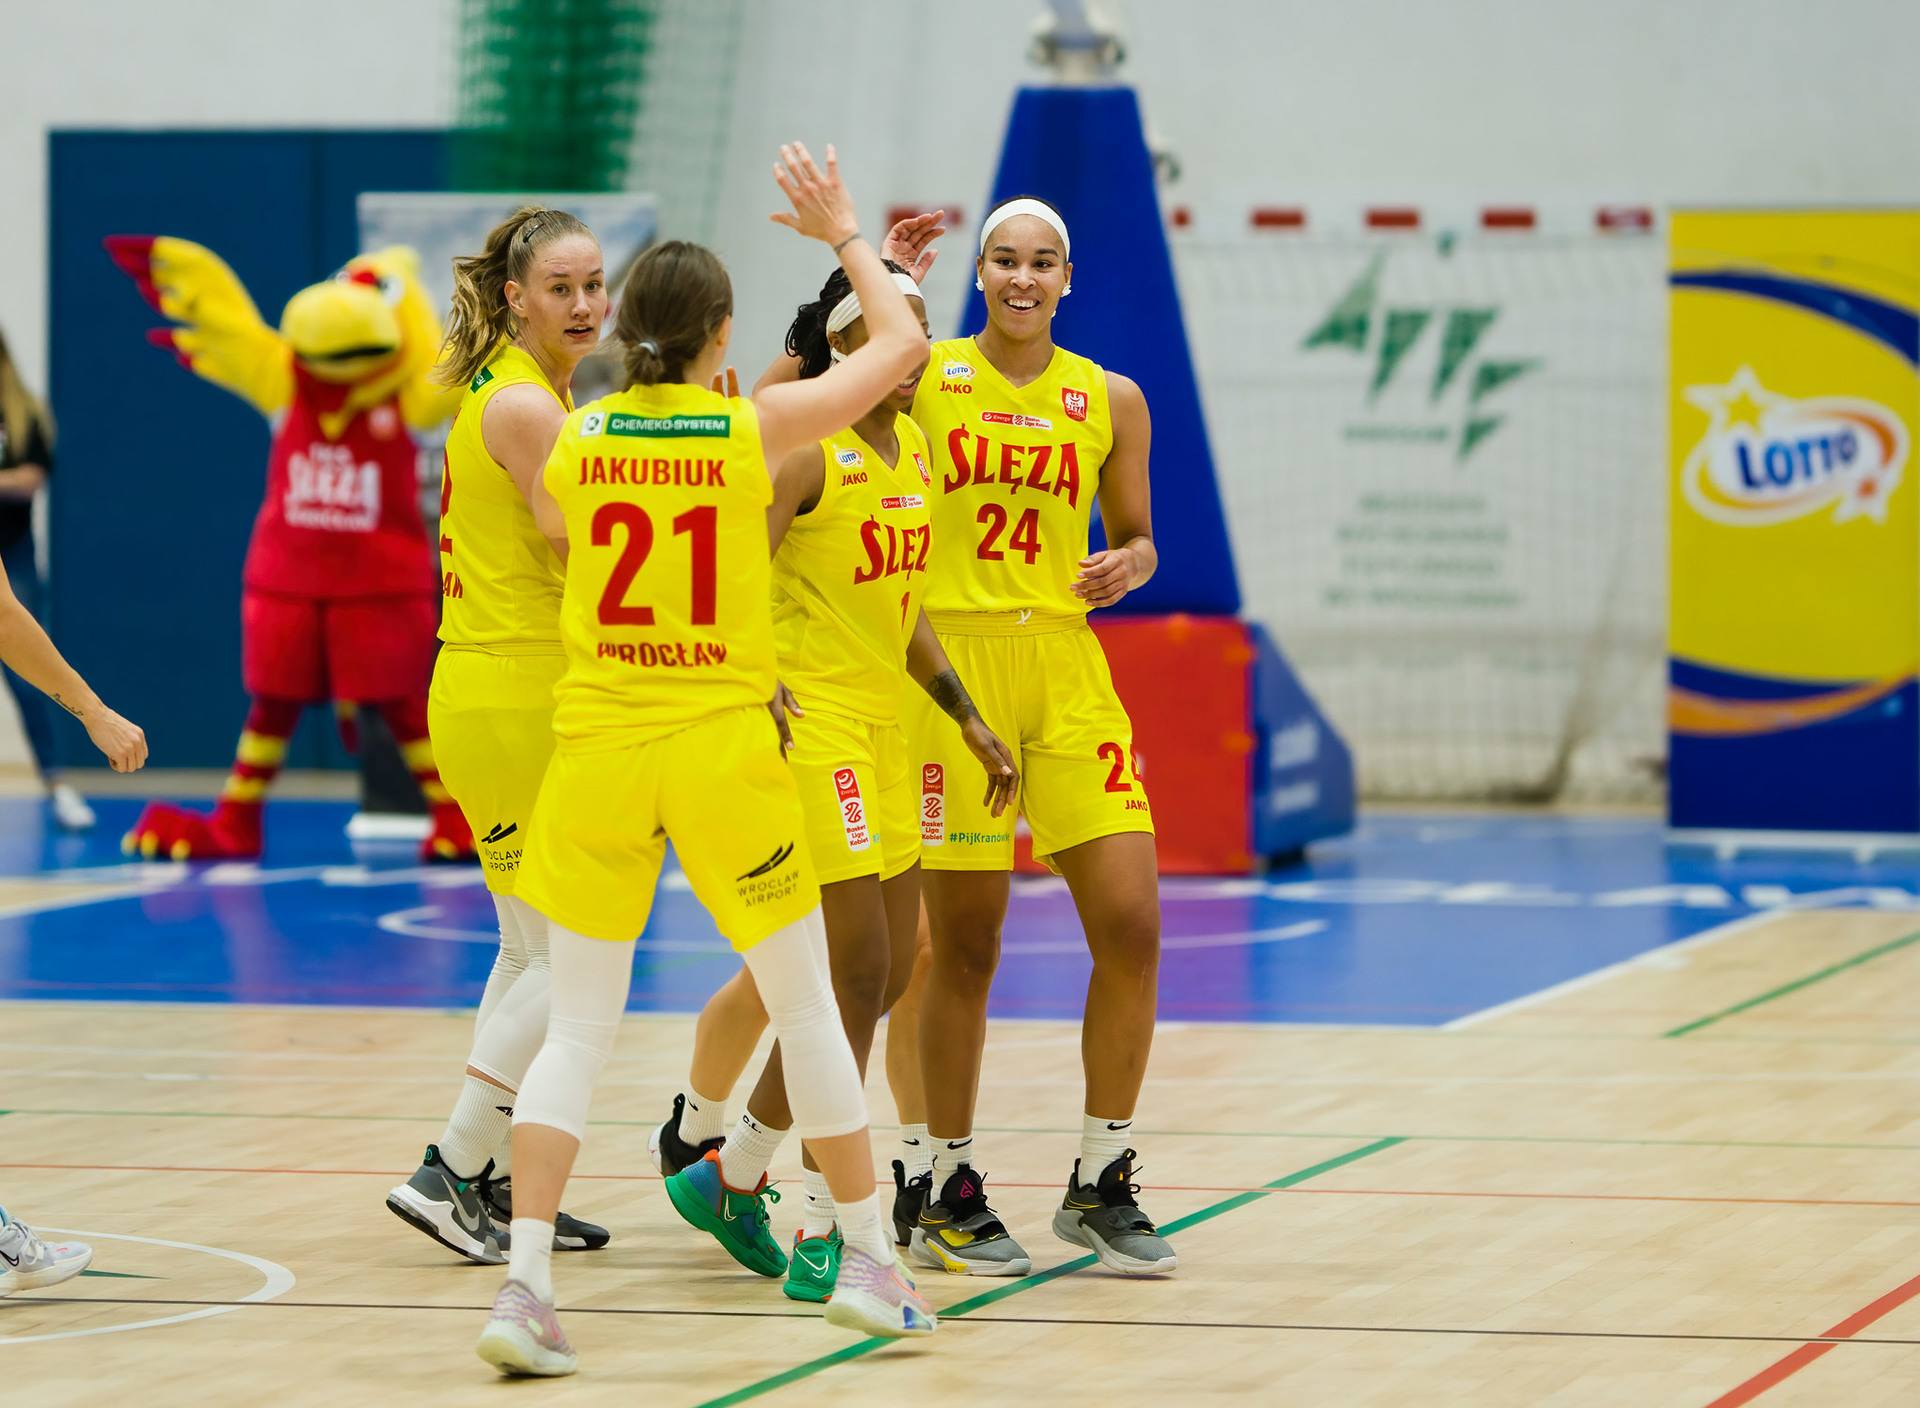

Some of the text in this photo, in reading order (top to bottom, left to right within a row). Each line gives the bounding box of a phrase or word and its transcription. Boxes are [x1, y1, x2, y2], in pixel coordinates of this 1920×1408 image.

[939, 381, 973, 394] JAKO
[579, 456, 727, 487] JAKUBIUK
[944, 423, 1080, 511] ŚLĘZA
[1734, 427, 1858, 491] LOTTO
[841, 472, 868, 486] JAKO
[976, 503, 1042, 565] 24
[854, 514, 931, 585] ŚLĘZ
[591, 501, 718, 626] 21
[597, 641, 727, 668] WROCŁAW
[1125, 800, 1148, 811] JAKO
[851, 832, 864, 840] Liga
[737, 870, 800, 897] WROCLAW
[745, 883, 797, 908] AIRPORT
